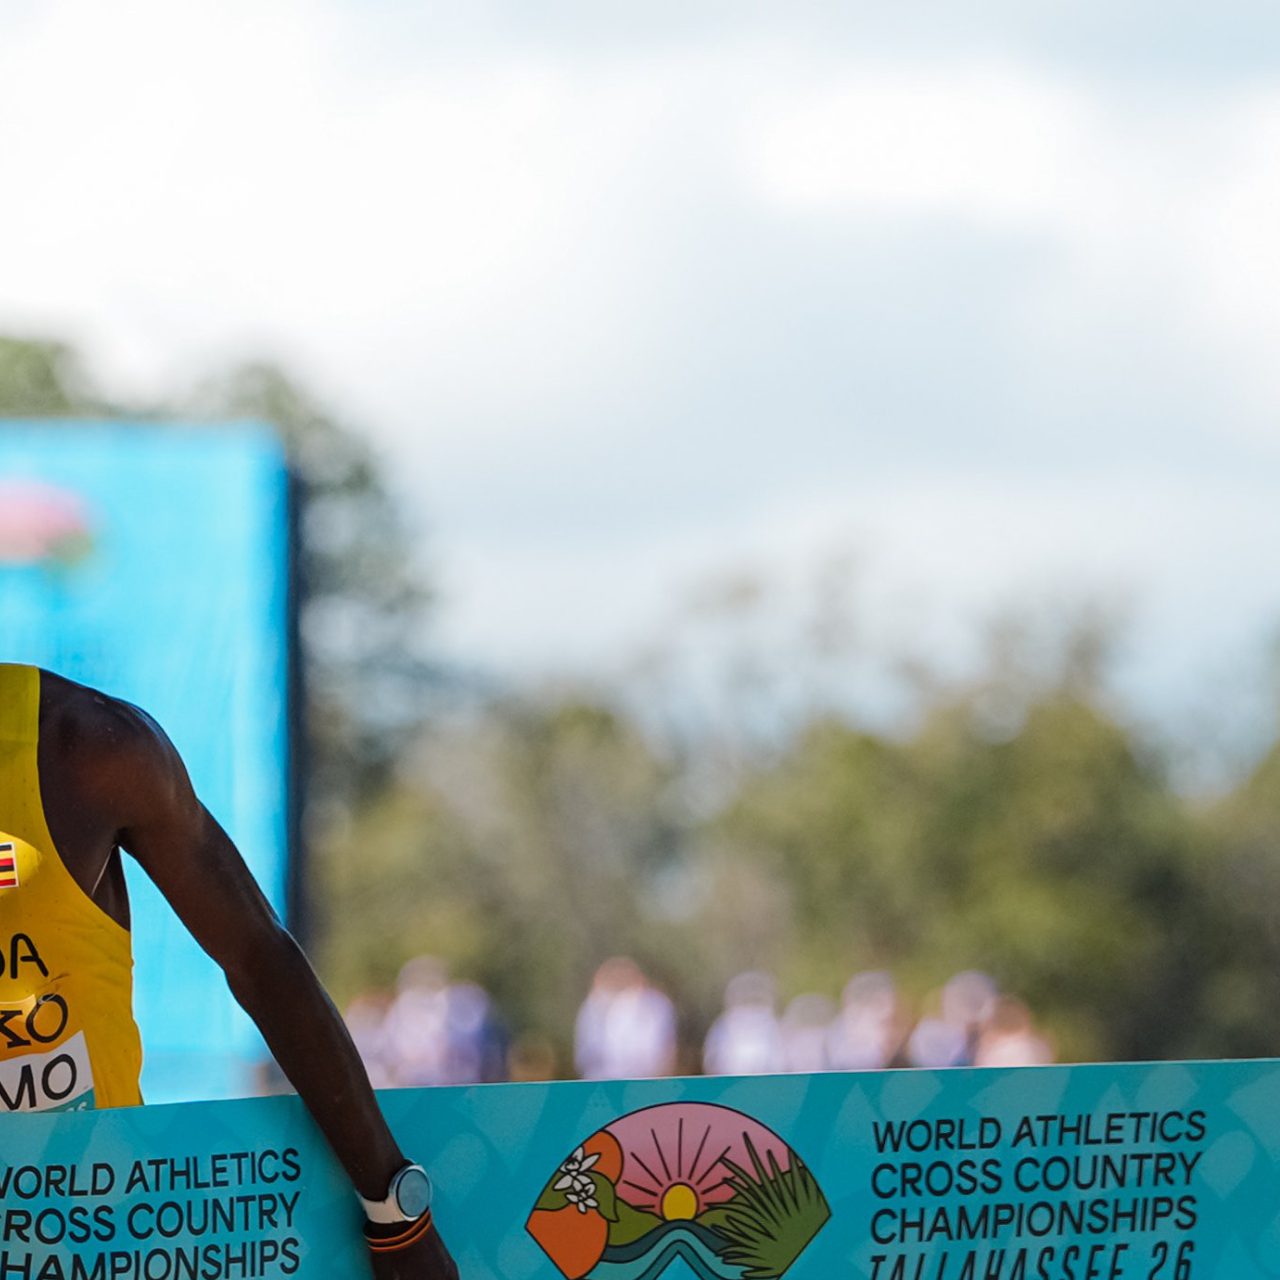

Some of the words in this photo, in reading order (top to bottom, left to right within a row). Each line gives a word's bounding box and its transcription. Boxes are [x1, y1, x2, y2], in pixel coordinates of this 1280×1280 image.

[872, 1117, 1002, 1153] WORLD
[1010, 1110, 1206, 1148] ATHLETICS
[124, 1148, 301, 1194] ATHLETICS
[871, 1158, 1002, 1199] CROSS
[1014, 1151, 1203, 1192] COUNTRY
[127, 1191, 301, 1240] COUNTRY
[870, 1195, 1198, 1245] CHAMPIONSHIPS
